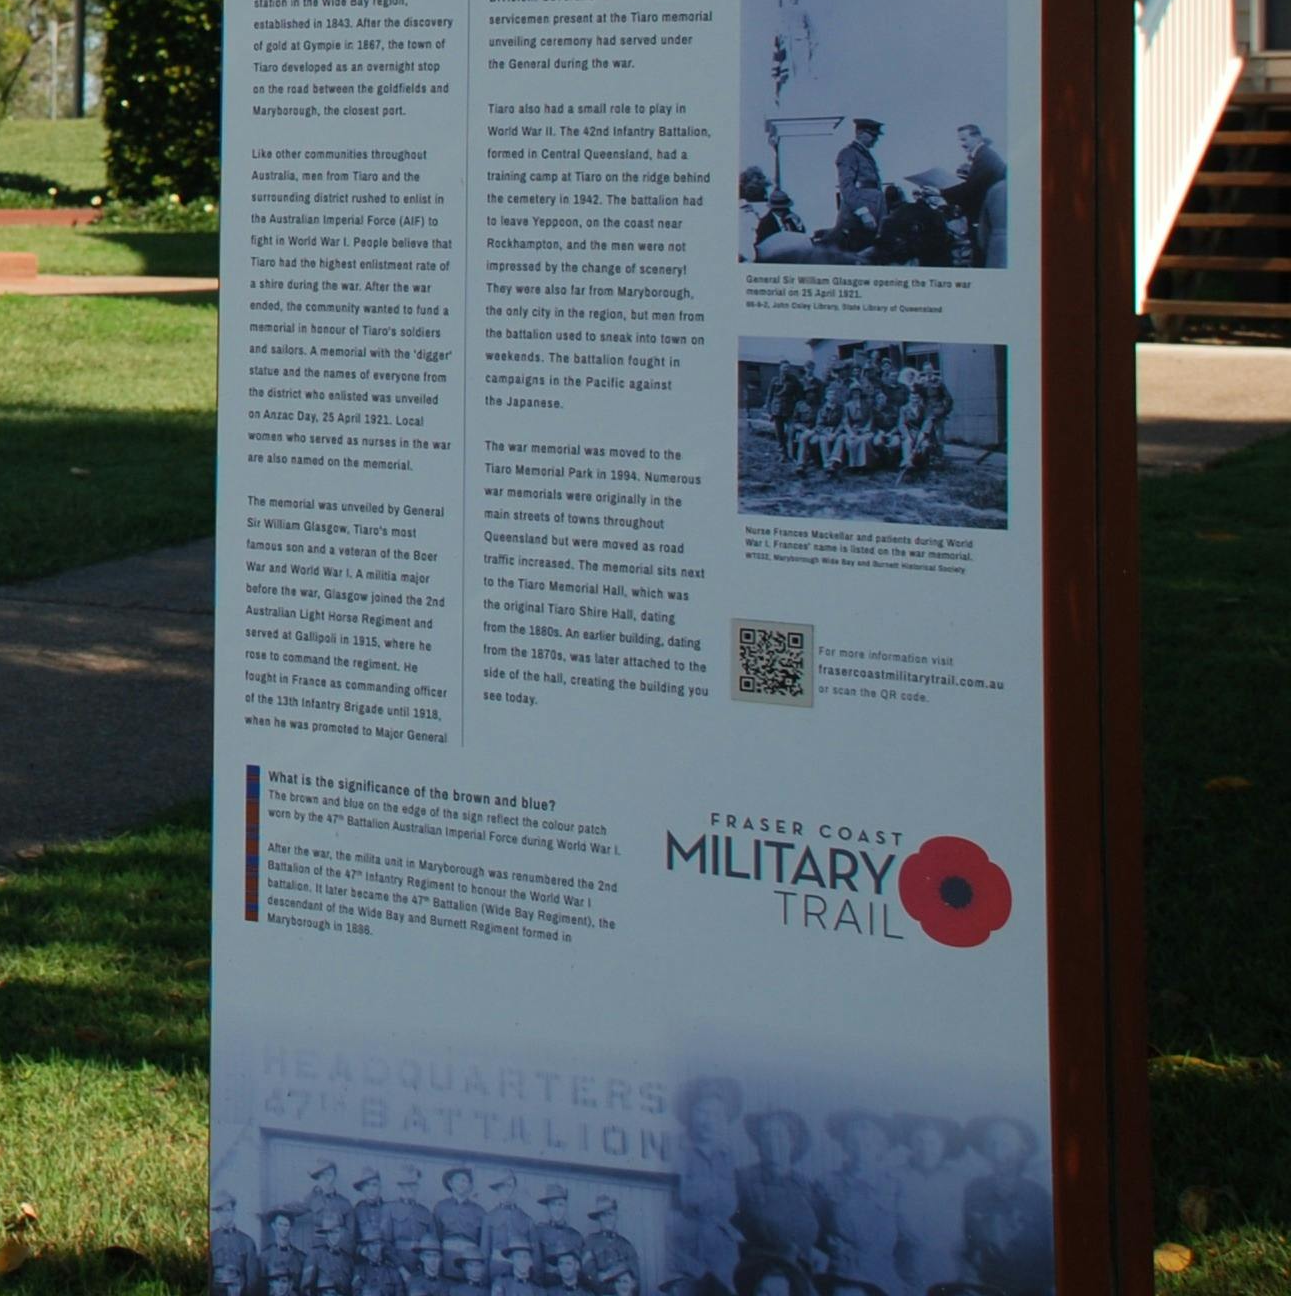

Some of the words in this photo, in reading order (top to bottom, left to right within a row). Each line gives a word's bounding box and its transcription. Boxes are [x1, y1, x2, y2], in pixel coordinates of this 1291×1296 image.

[253, 18, 310, 29] established
[313, 18, 322, 28] in
[325, 17, 353, 28] 1843.
[355, 17, 380, 27] After
[383, 17, 400, 27] the
[403, 16, 453, 28] discovery
[488, 103, 514, 113] Tiaro
[518, 103, 540, 114] also
[544, 103, 564, 114] had
[567, 105, 574, 113] a
[577, 103, 606, 113] small
[609, 103, 631, 114] role
[634, 103, 645, 114] to
[649, 103, 672, 116] play
[675, 103, 686, 113] in
[487, 126, 518, 136] World
[521, 126, 542, 136] War
[545, 126, 556, 136] II.
[559, 125, 579, 136] The
[582, 125, 609, 136] 42nd
[612, 125, 654, 138] Infantry
[658, 126, 711, 137] Battalion,
[251, 148, 272, 158] Like
[275, 148, 301, 159] other
[304, 149, 368, 159] communities
[370, 149, 426, 161] throughout
[251, 170, 299, 181] Australia,
[301, 172, 323, 181] men
[326, 170, 348, 181] from
[352, 170, 378, 181] Tiaro
[381, 170, 400, 181] and
[403, 171, 420, 182] the
[745, 274, 780, 283] General
[782, 275, 795, 284] Sir
[797, 276, 829, 284] William
[831, 276, 870, 287] Glasgow
[873, 279, 909, 288] opening
[911, 279, 926, 287] the
[929, 278, 952, 288] Tiaro
[484, 440, 504, 451] The
[507, 443, 527, 452] war
[530, 444, 580, 455] memorial
[583, 447, 605, 456] was
[609, 448, 645, 458] moved
[649, 449, 660, 459] to
[663, 449, 681, 460] the
[247, 495, 265, 506] The
[268, 498, 314, 509] memorial
[317, 502, 337, 510] was
[341, 502, 384, 513] unveiled
[387, 503, 399, 516] by
[403, 504, 444, 517] General
[247, 517, 260, 527] Sir
[263, 518, 300, 530] William
[303, 520, 351, 534] Glasgow,
[353, 523, 388, 536] Tiaro's
[391, 528, 416, 537] most
[745, 526, 770, 535] Nurse
[772, 527, 808, 537] Frances
[856, 533, 872, 542] and
[875, 535, 911, 544] patients
[914, 536, 944, 548] during
[945, 538, 973, 548] World
[818, 645, 835, 656] For
[839, 649, 864, 659] more
[868, 650, 927, 663] information
[931, 655, 953, 666] visit
[818, 664, 1004, 689] frasercoastmilitarytrail.com.au
[483, 691, 502, 701] see
[505, 692, 538, 706] today.
[818, 685, 829, 693] or
[832, 686, 856, 696] scan
[859, 687, 876, 698] the
[880, 688, 896, 700] QR
[900, 692, 930, 702] code.
[244, 715, 270, 726] when
[273, 716, 286, 728] he
[289, 720, 308, 729] was
[311, 722, 359, 734] promoted
[362, 725, 372, 735] to
[375, 726, 403, 740] Major
[406, 729, 447, 743] General
[268, 770, 297, 784] What
[301, 773, 311, 785] is
[315, 775, 333, 788] the
[338, 778, 409, 795] significance
[413, 785, 425, 797] of
[429, 787, 448, 800] the
[452, 789, 490, 804] brown
[494, 795, 516, 807] and
[521, 796, 555, 811] blue?
[710, 812, 804, 837] FRASER
[819, 824, 903, 847] COAST
[666, 830, 896, 895] MILITARY
[774, 890, 904, 939] TRAIL
[263, 1044, 668, 1115] HEADQUARTERS
[361, 1096, 669, 1161] BATTALION
